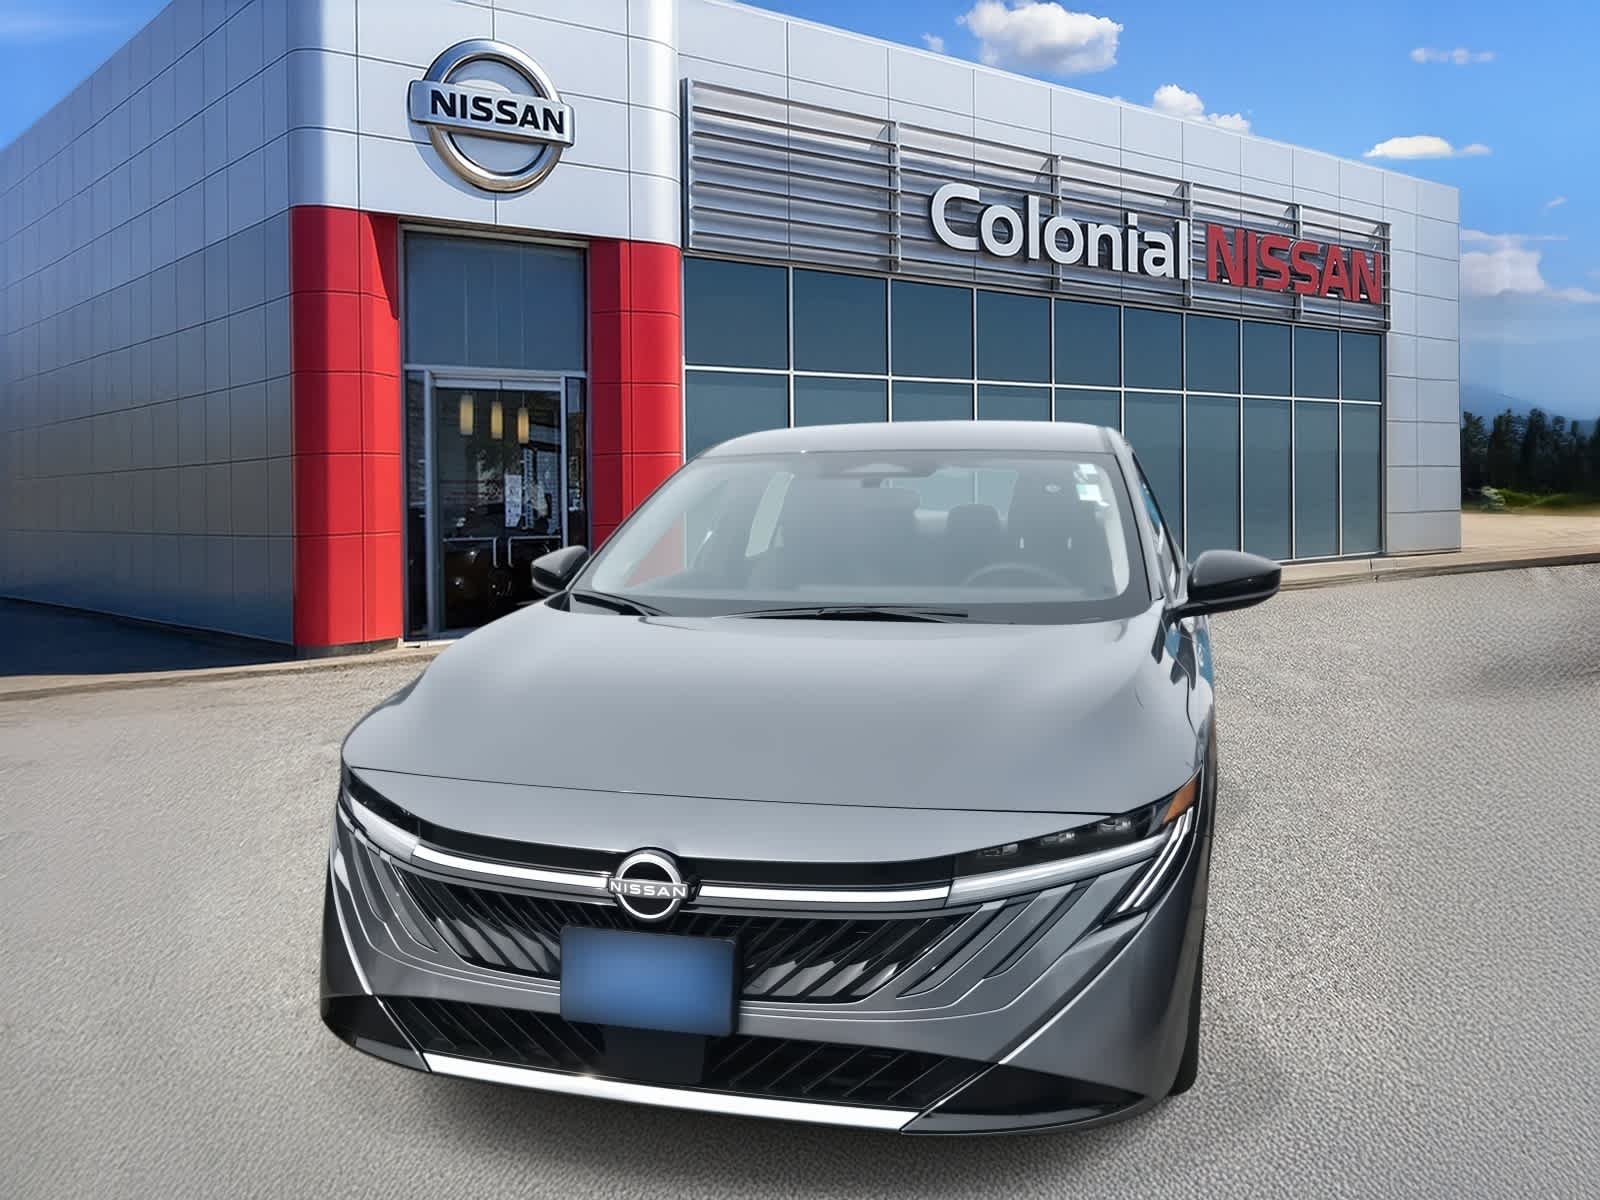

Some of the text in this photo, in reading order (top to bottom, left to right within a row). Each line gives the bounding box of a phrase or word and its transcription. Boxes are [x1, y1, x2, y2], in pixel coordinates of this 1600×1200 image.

[430, 89, 564, 134] NISSAN
[930, 183, 1383, 304] Colonial NISSAN
[610, 881, 686, 897] NISSAN
